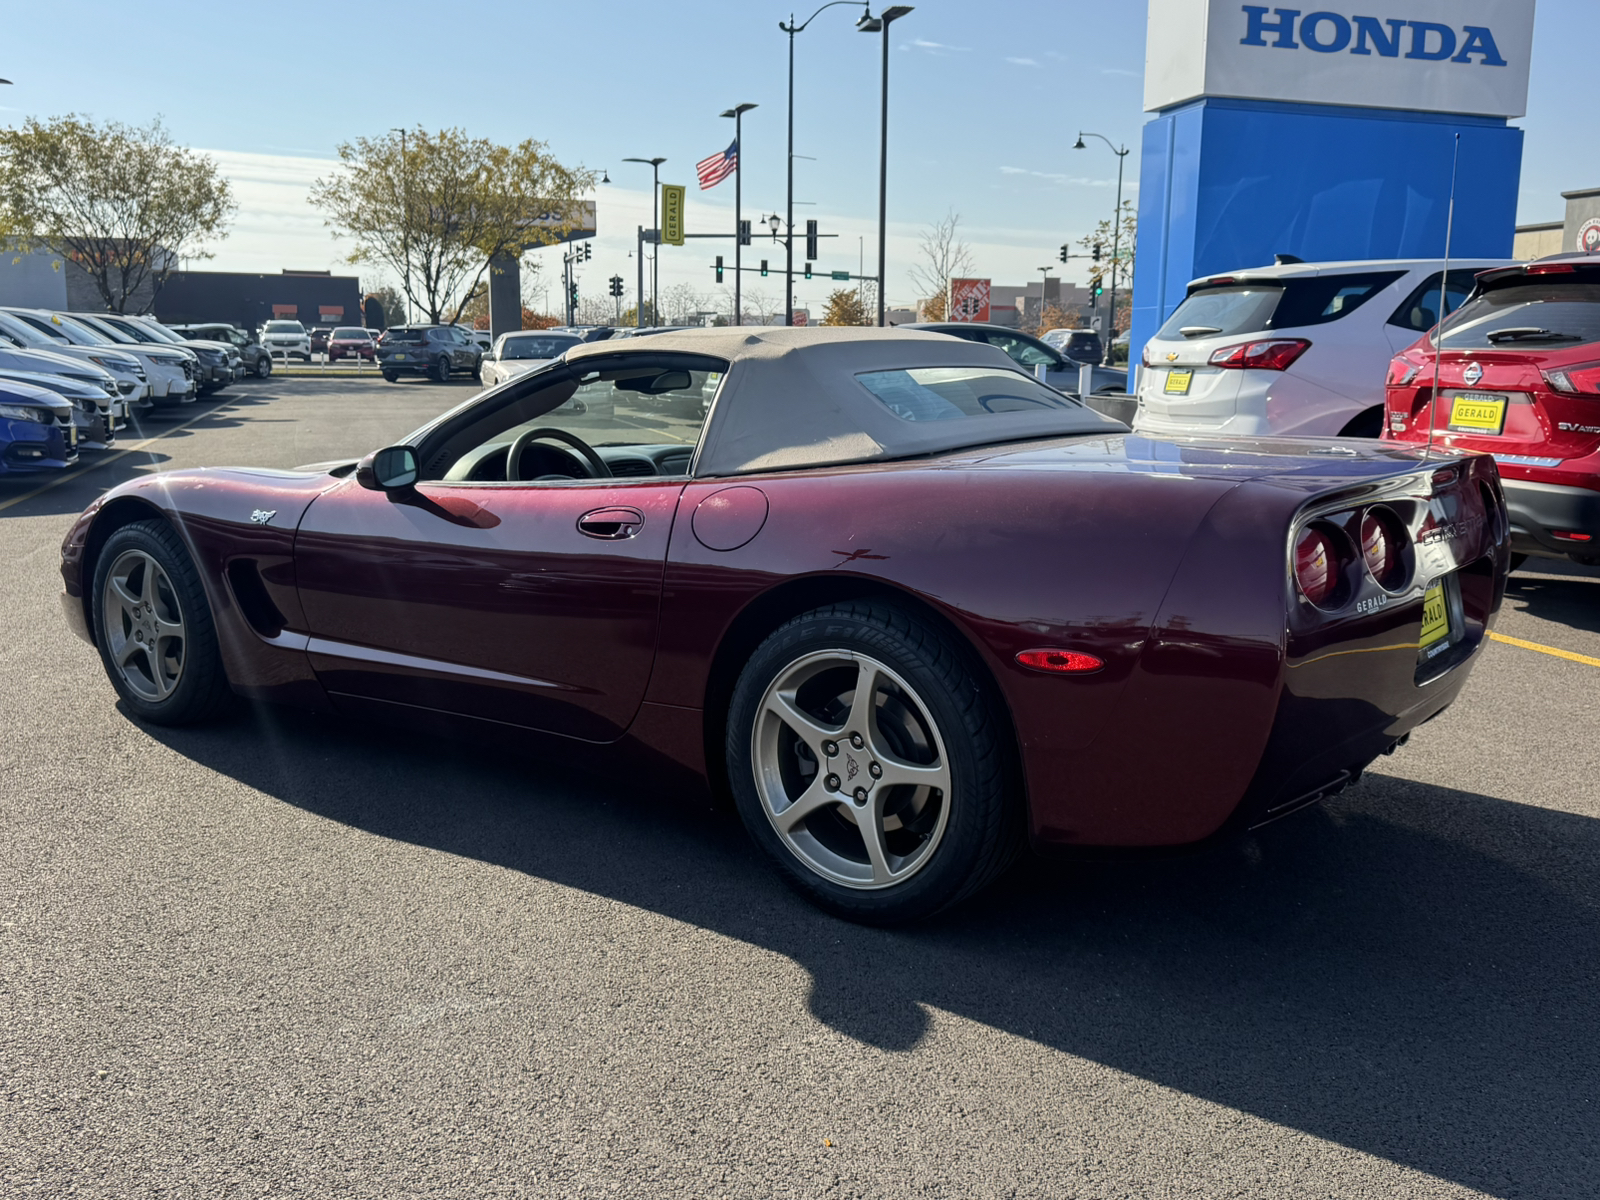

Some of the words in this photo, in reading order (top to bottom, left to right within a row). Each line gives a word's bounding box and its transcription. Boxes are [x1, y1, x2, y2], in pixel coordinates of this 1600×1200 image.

[1240, 5, 1507, 67] HONDA
[669, 192, 677, 237] GERALD
[1458, 408, 1495, 419] GERALD
[1558, 421, 1580, 431] SV
[1356, 593, 1387, 613] GERALD
[1421, 603, 1443, 628] RALD
